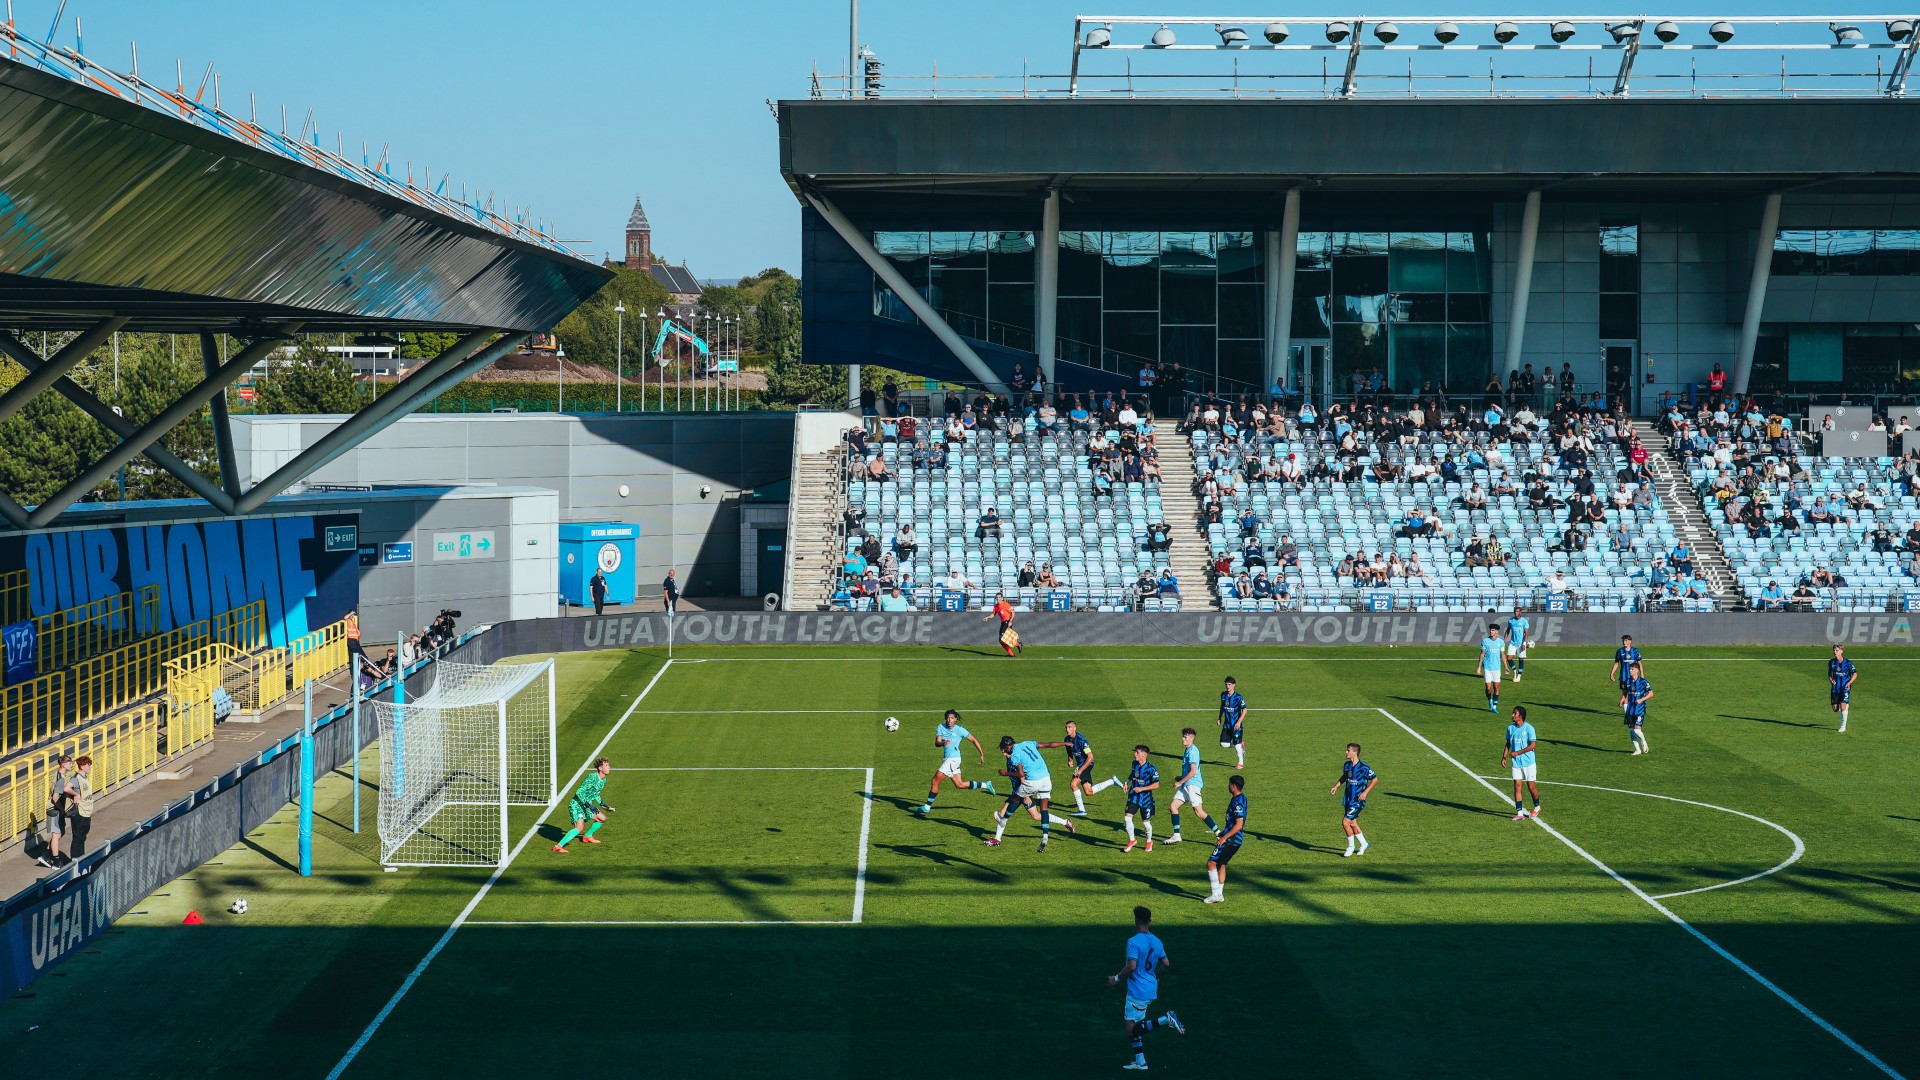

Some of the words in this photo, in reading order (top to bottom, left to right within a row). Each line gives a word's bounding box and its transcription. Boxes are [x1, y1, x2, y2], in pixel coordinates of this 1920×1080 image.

[342, 533, 354, 542] EXIT
[437, 541, 454, 552] Exit
[25, 528, 127, 629] OUR
[127, 516, 324, 654] HOME
[946, 600, 959, 609] E1
[1052, 600, 1065, 609] E1
[1374, 600, 1388, 610] E2
[1550, 601, 1564, 610] E2
[583, 617, 655, 648] UEFA
[661, 614, 787, 642] YOUTH
[796, 615, 934, 642] LEAGUE
[1197, 616, 1284, 643] UEFA
[1292, 616, 1416, 643] YOUTH
[1825, 617, 1914, 643] UEFA
[1022, 745, 1039, 762] 11
[1346, 807, 1356, 817] 7
[31, 890, 83, 970] UEFA
[87, 857, 134, 936] YOUTH
[139, 814, 201, 893] LEAGUE
[1145, 947, 1155, 972] 6
